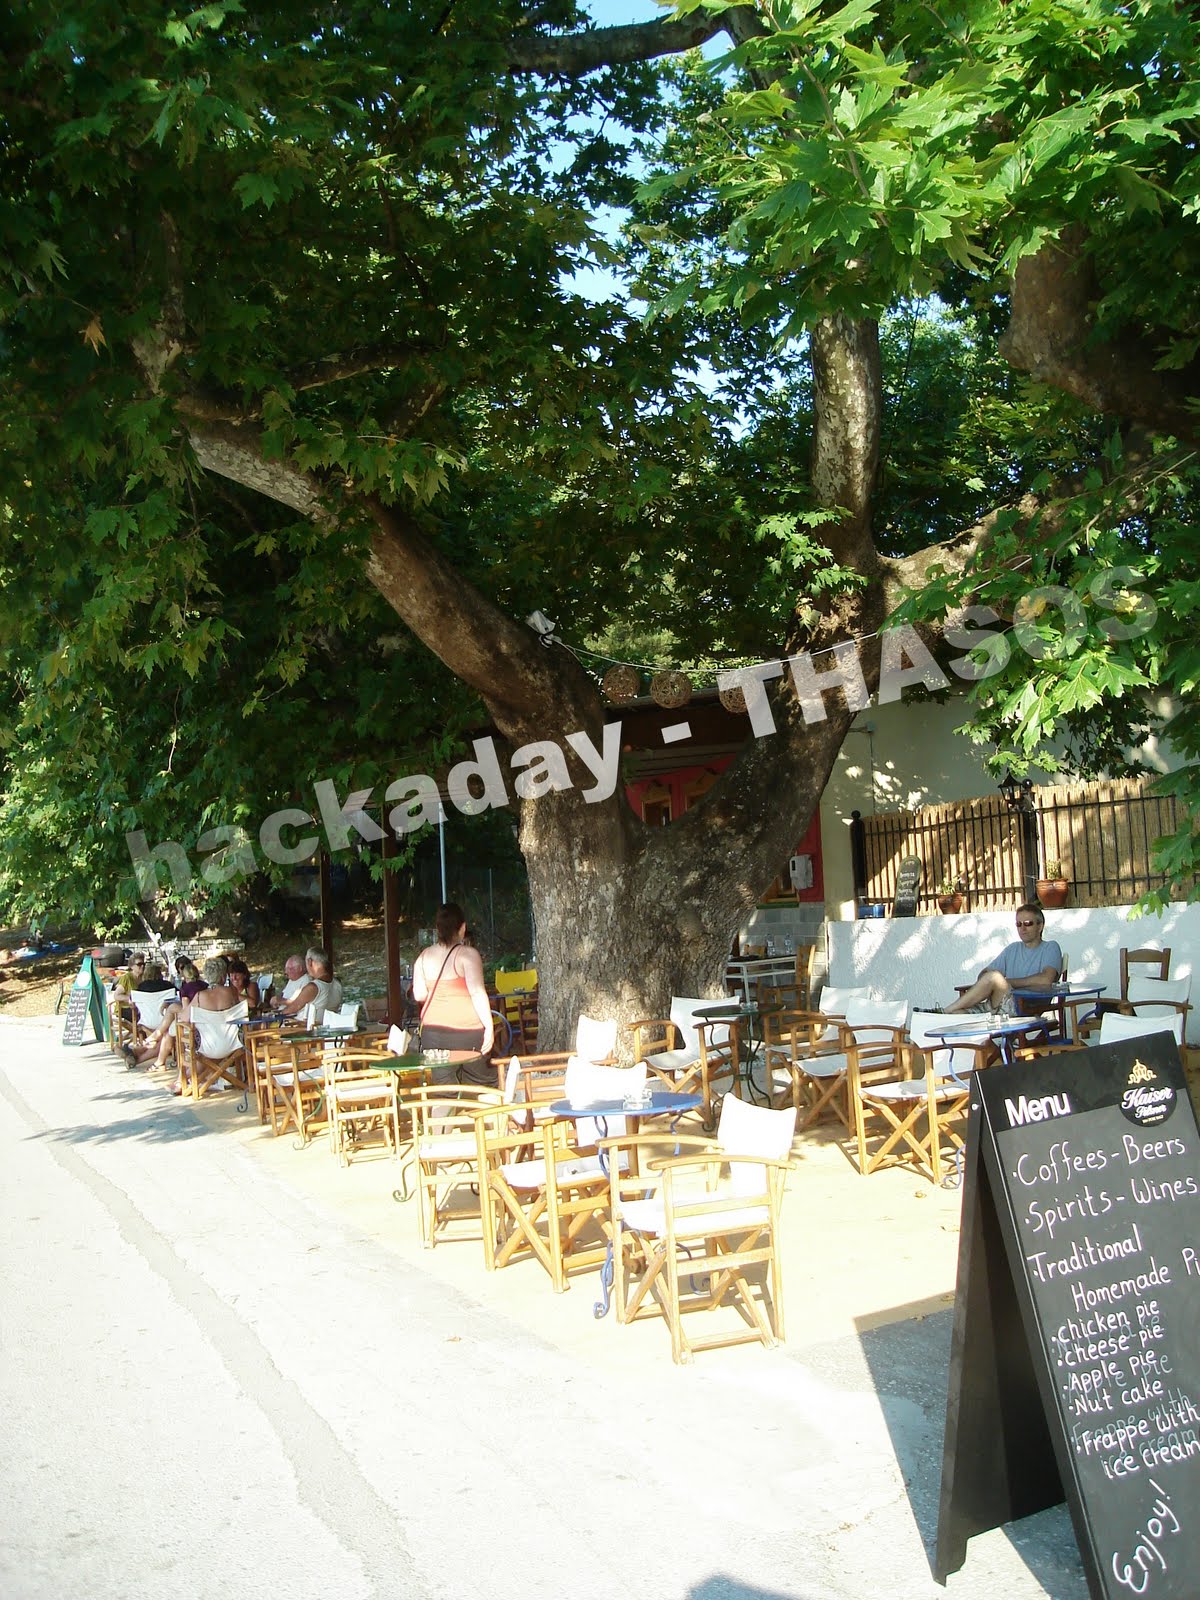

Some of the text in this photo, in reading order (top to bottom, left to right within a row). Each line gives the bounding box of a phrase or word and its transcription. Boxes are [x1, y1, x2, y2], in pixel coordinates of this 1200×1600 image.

[1005, 1092, 1072, 1127] Menu
[1121, 1086, 1173, 1110] Kaiser
[1016, 1141, 1107, 1186] Coffees
[1122, 1133, 1186, 1165] Beers
[1028, 1185, 1112, 1239] Spirits
[1130, 1176, 1198, 1204] Wines
[1027, 1223, 1143, 1283] Traditional
[1070, 1256, 1172, 1313] Homemade
[1135, 1300, 1160, 1325] pie
[1138, 1324, 1164, 1348] pie
[1071, 1349, 1157, 1394] Apple pie
[1074, 1377, 1164, 1416] Nut cake
[1081, 1399, 1200, 1456] Frappe with
[1103, 1455, 1140, 1479] ice
[1112, 1478, 1180, 1593] Enjoy!
